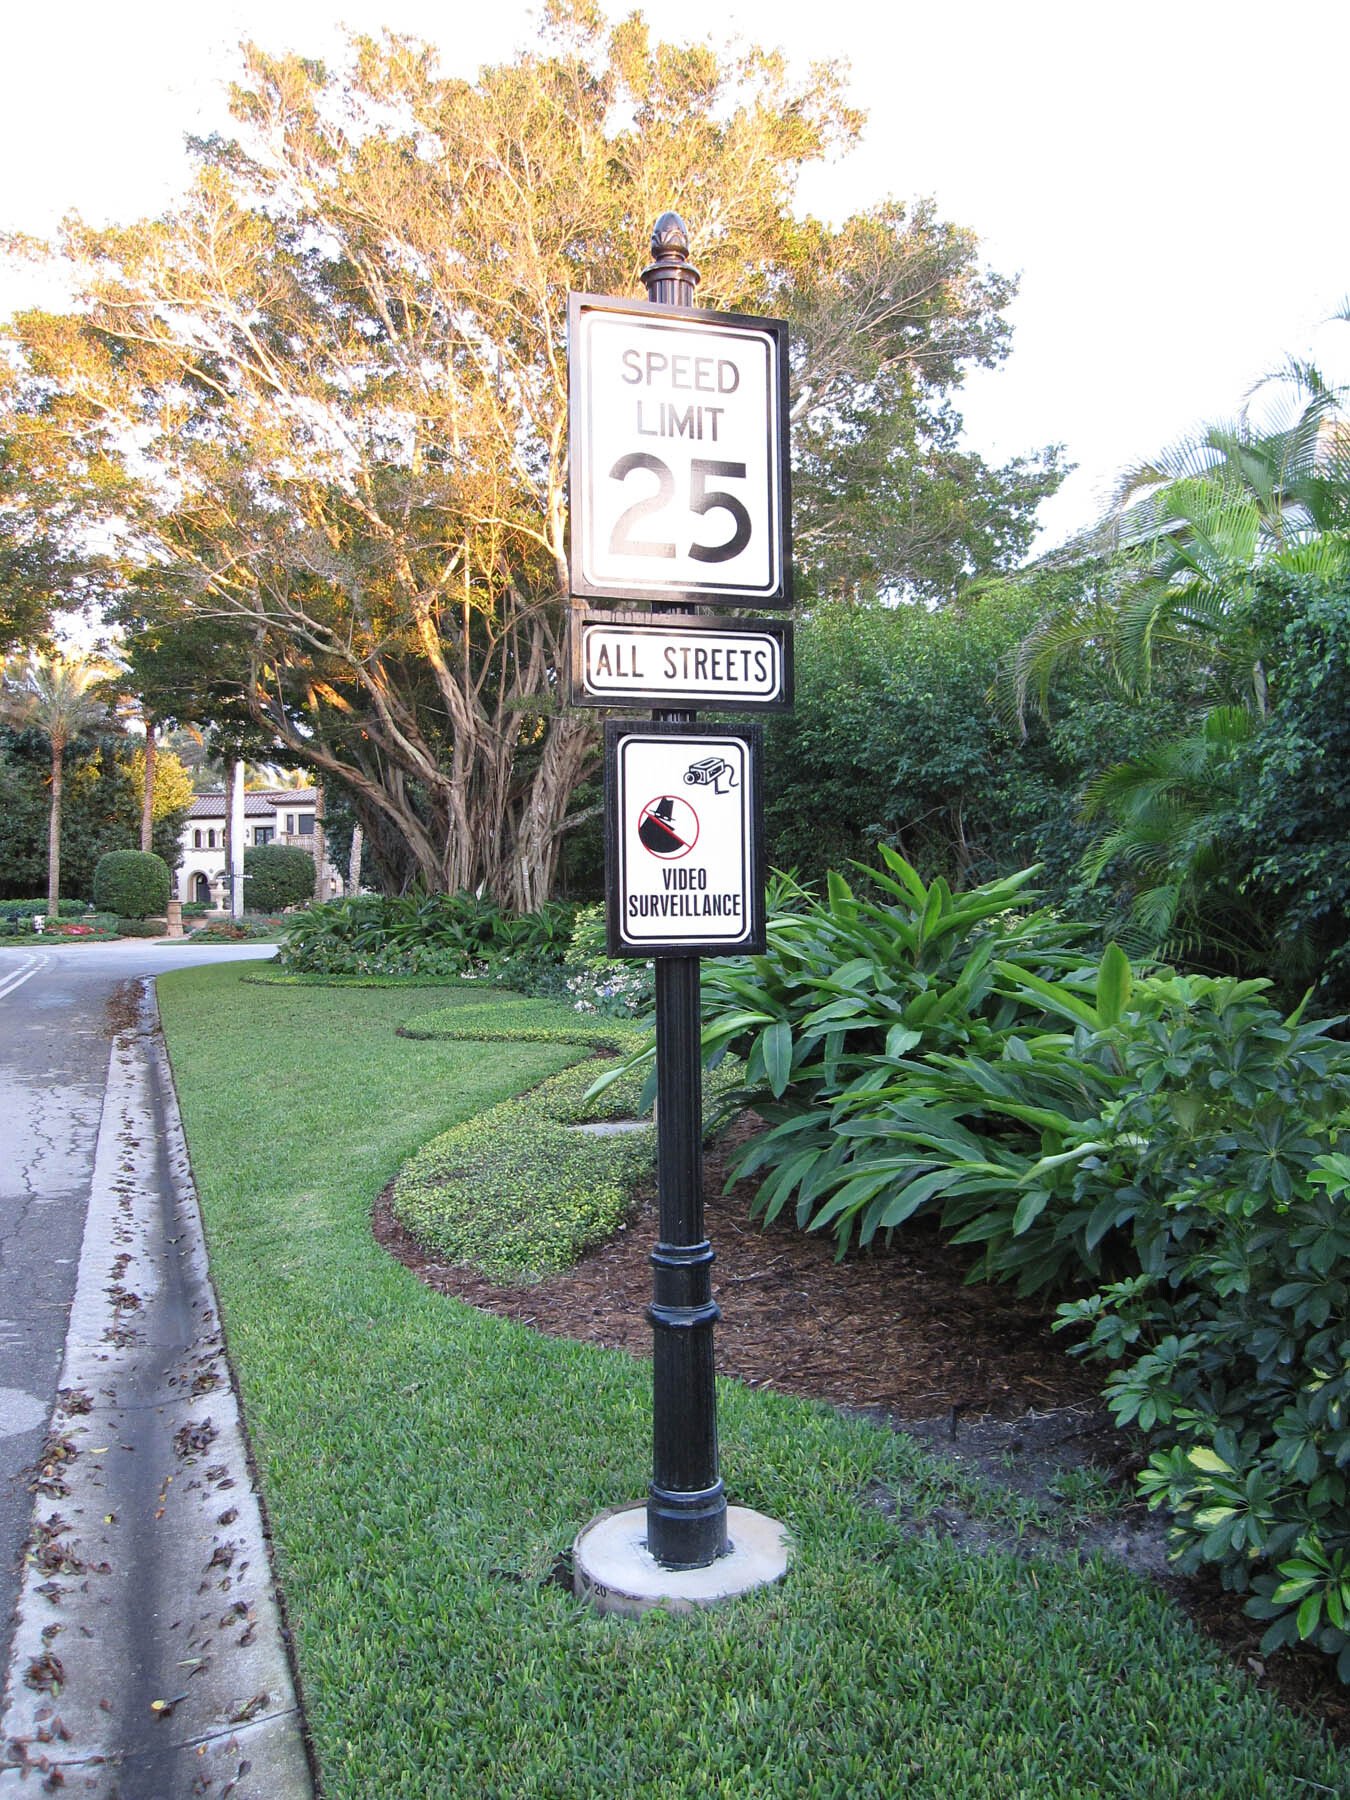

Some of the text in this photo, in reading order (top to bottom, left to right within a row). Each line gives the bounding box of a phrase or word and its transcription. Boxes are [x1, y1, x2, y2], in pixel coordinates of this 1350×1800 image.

[621, 349, 740, 394] SPEED
[637, 400, 724, 442] LIMIT
[608, 452, 752, 563] 25
[596, 644, 767, 682] ALL STREETS
[662, 868, 706, 890] VIDEO
[629, 894, 741, 917] SURVEILLANCE
